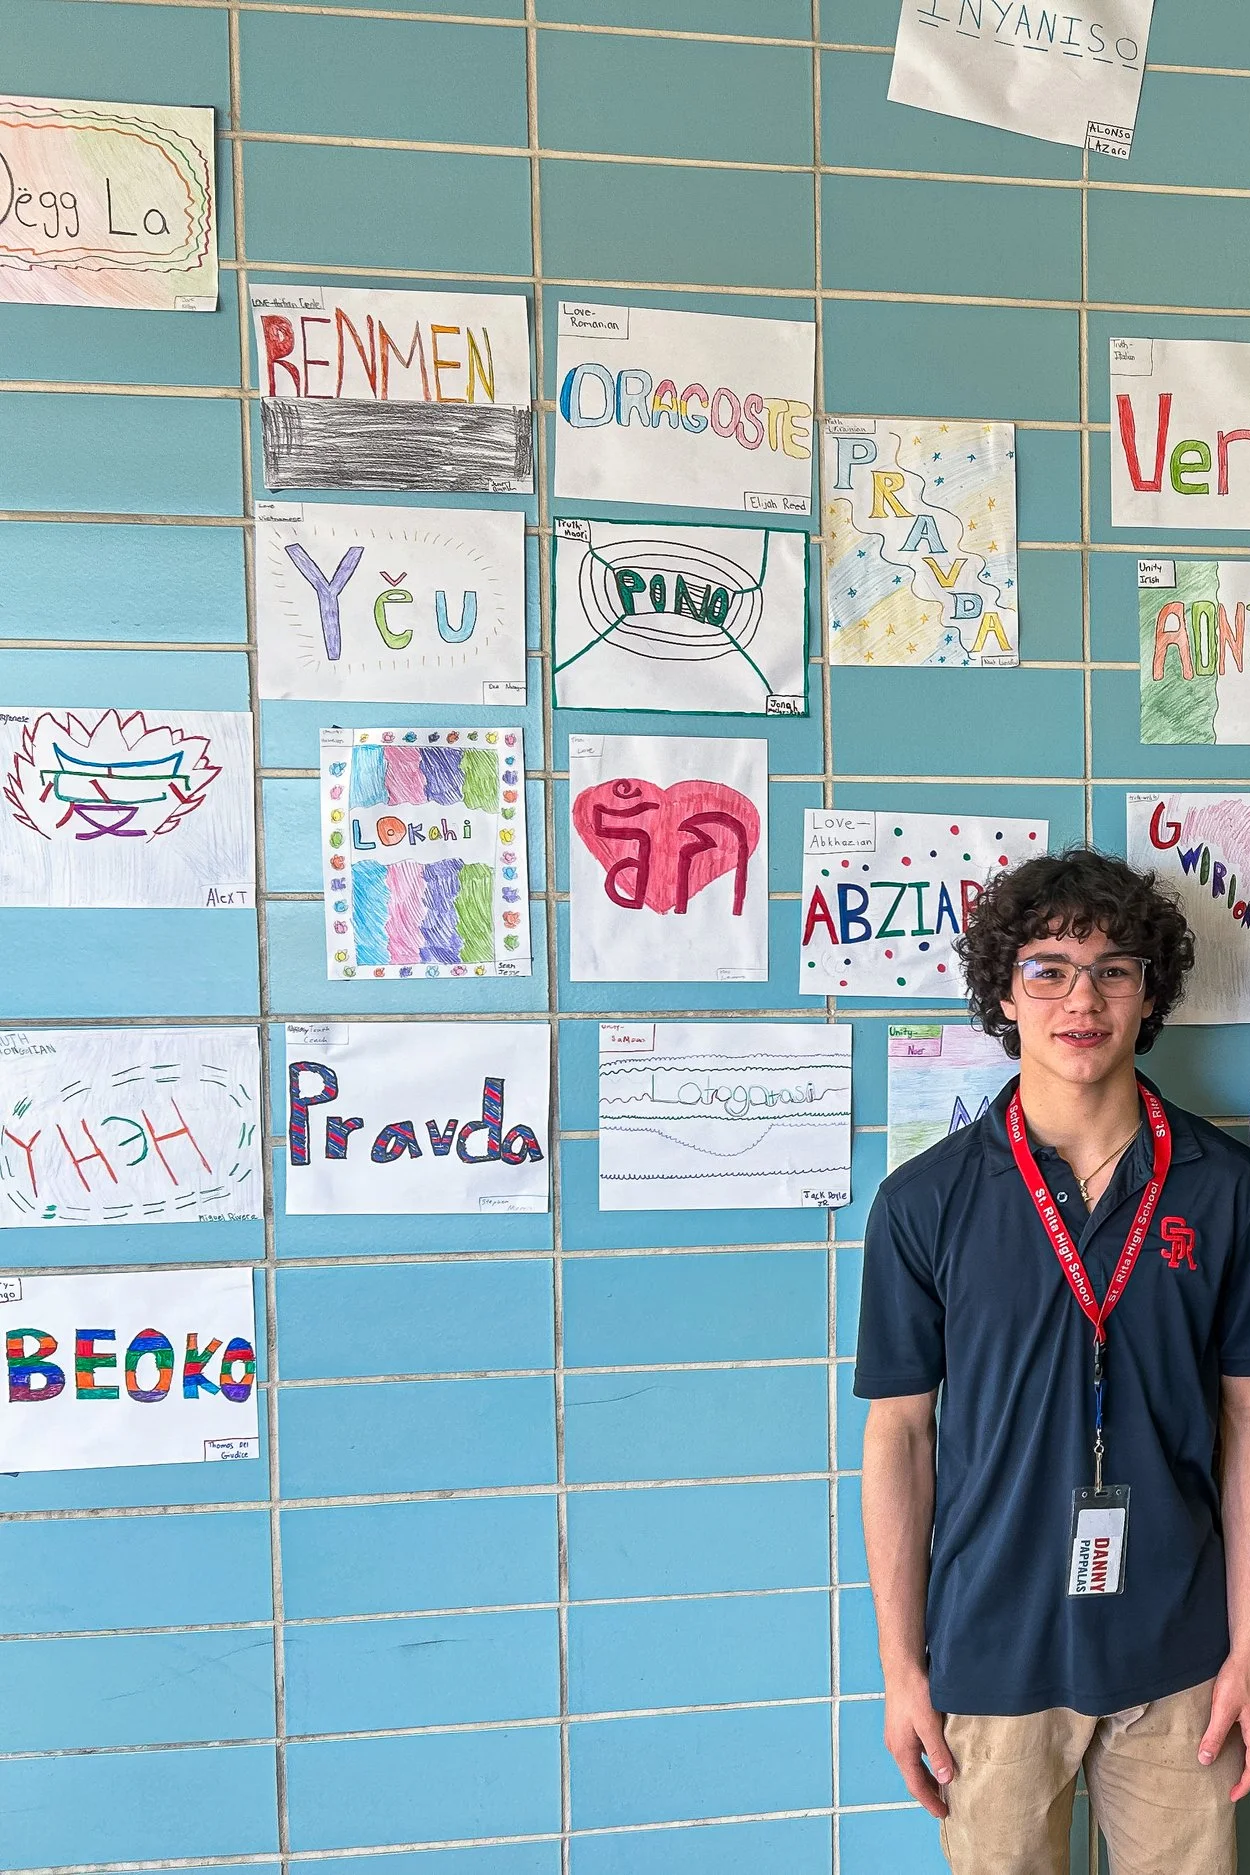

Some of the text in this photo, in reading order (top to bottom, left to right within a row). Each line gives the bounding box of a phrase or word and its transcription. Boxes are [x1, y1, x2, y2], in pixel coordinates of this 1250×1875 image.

[106, 176, 170, 236] La
[570, 317, 620, 330] Romanian
[260, 307, 496, 404] RENMEN
[560, 363, 812, 460] DRAGOSTE
[782, 497, 807, 511] Reed
[832, 437, 1013, 653] PRAVDA
[1139, 562, 1163, 573] Unity
[616, 568, 730, 627] PONO
[206, 887, 248, 907] Alex T
[0, 1032, 30, 1047] UTH
[288, 1060, 545, 1166] Pravda
[1009, 1104, 1023, 1142] School
[1034, 1187, 1094, 1307] St. Rita High School
[1115, 1256, 1132, 1284] Rita
[1125, 1227, 1144, 1257] High
[1137, 1181, 1159, 1226] School
[1076, 1539, 1091, 1593] PAPPALAS
[1089, 1537, 1110, 1593] DANNY
